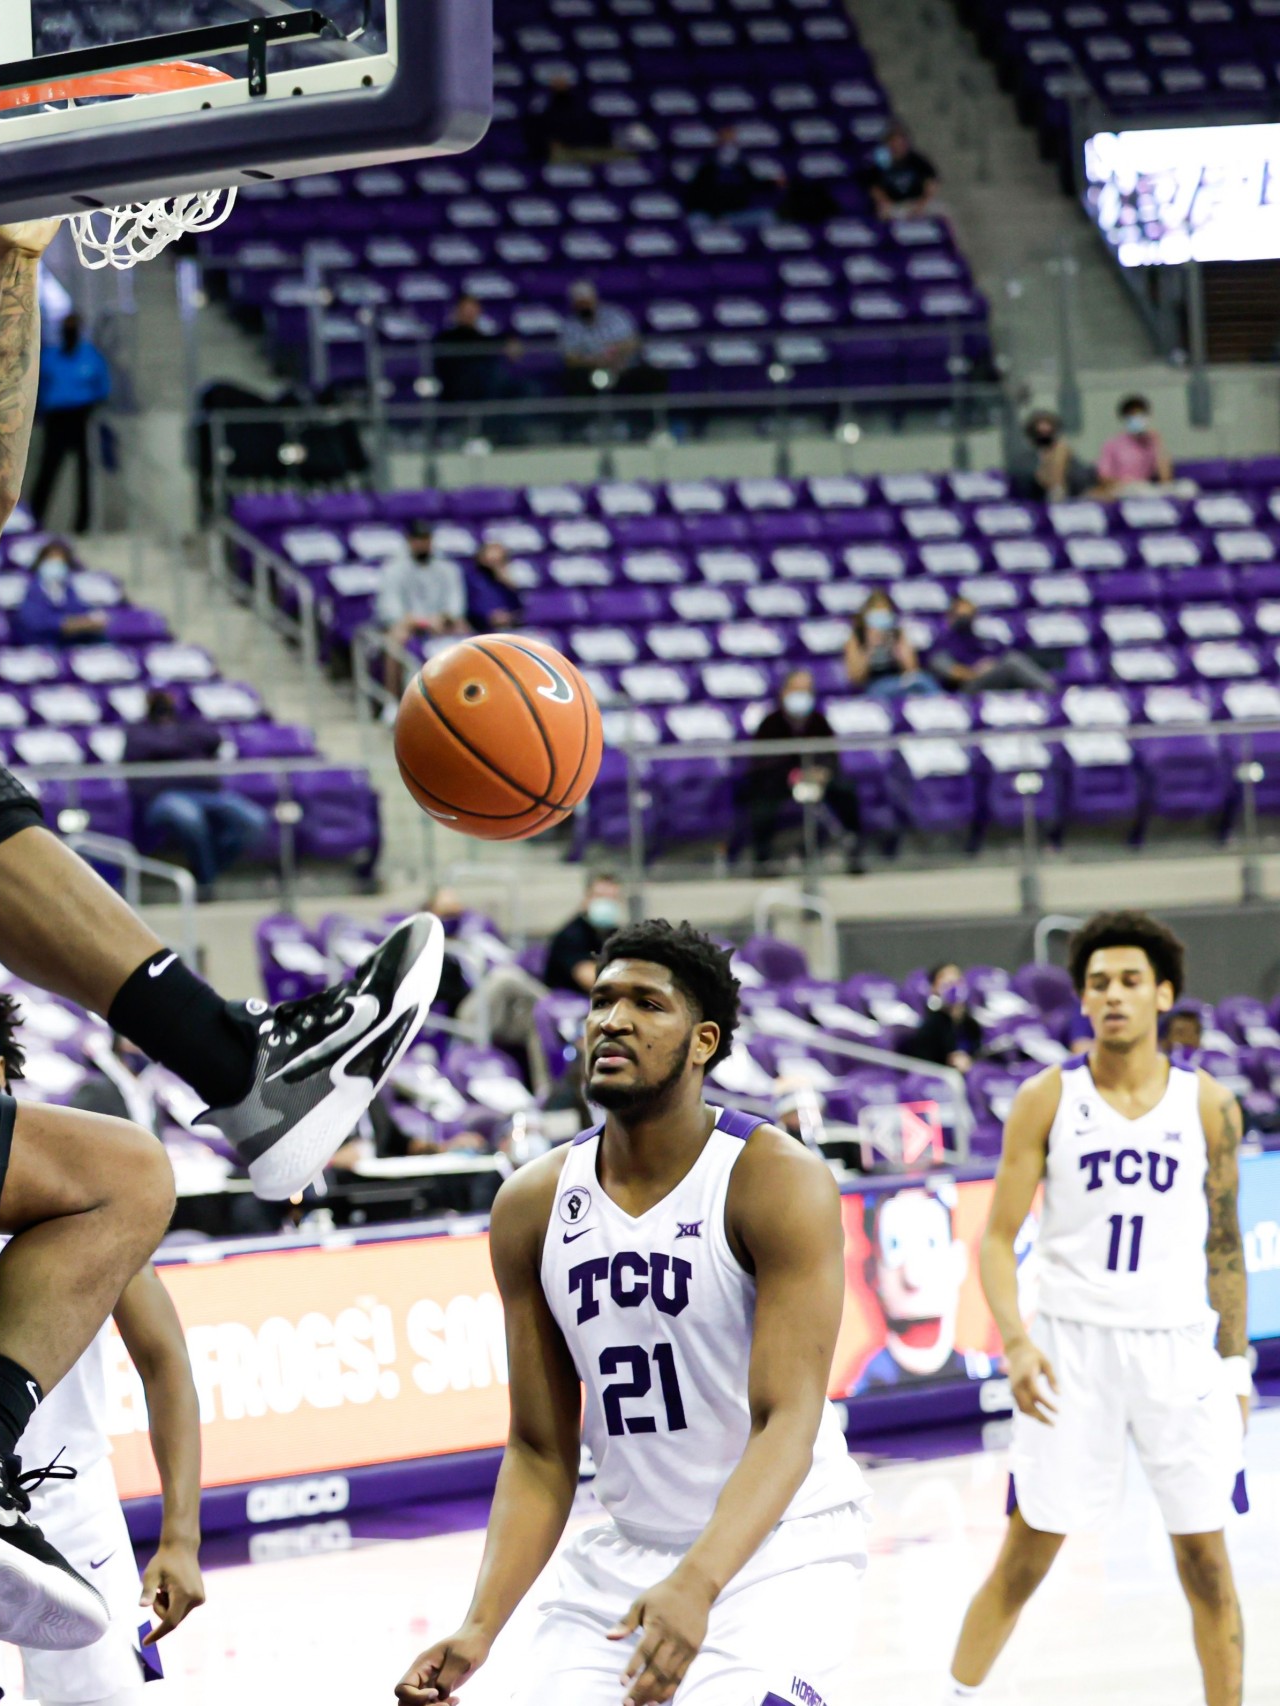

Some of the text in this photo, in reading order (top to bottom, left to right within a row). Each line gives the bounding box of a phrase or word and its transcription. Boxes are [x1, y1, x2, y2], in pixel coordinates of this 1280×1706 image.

[1080, 1149, 1178, 1193] TCU
[1106, 1214, 1144, 1272] 11
[569, 1251, 693, 1326] TCU
[599, 1342, 688, 1436] 21
